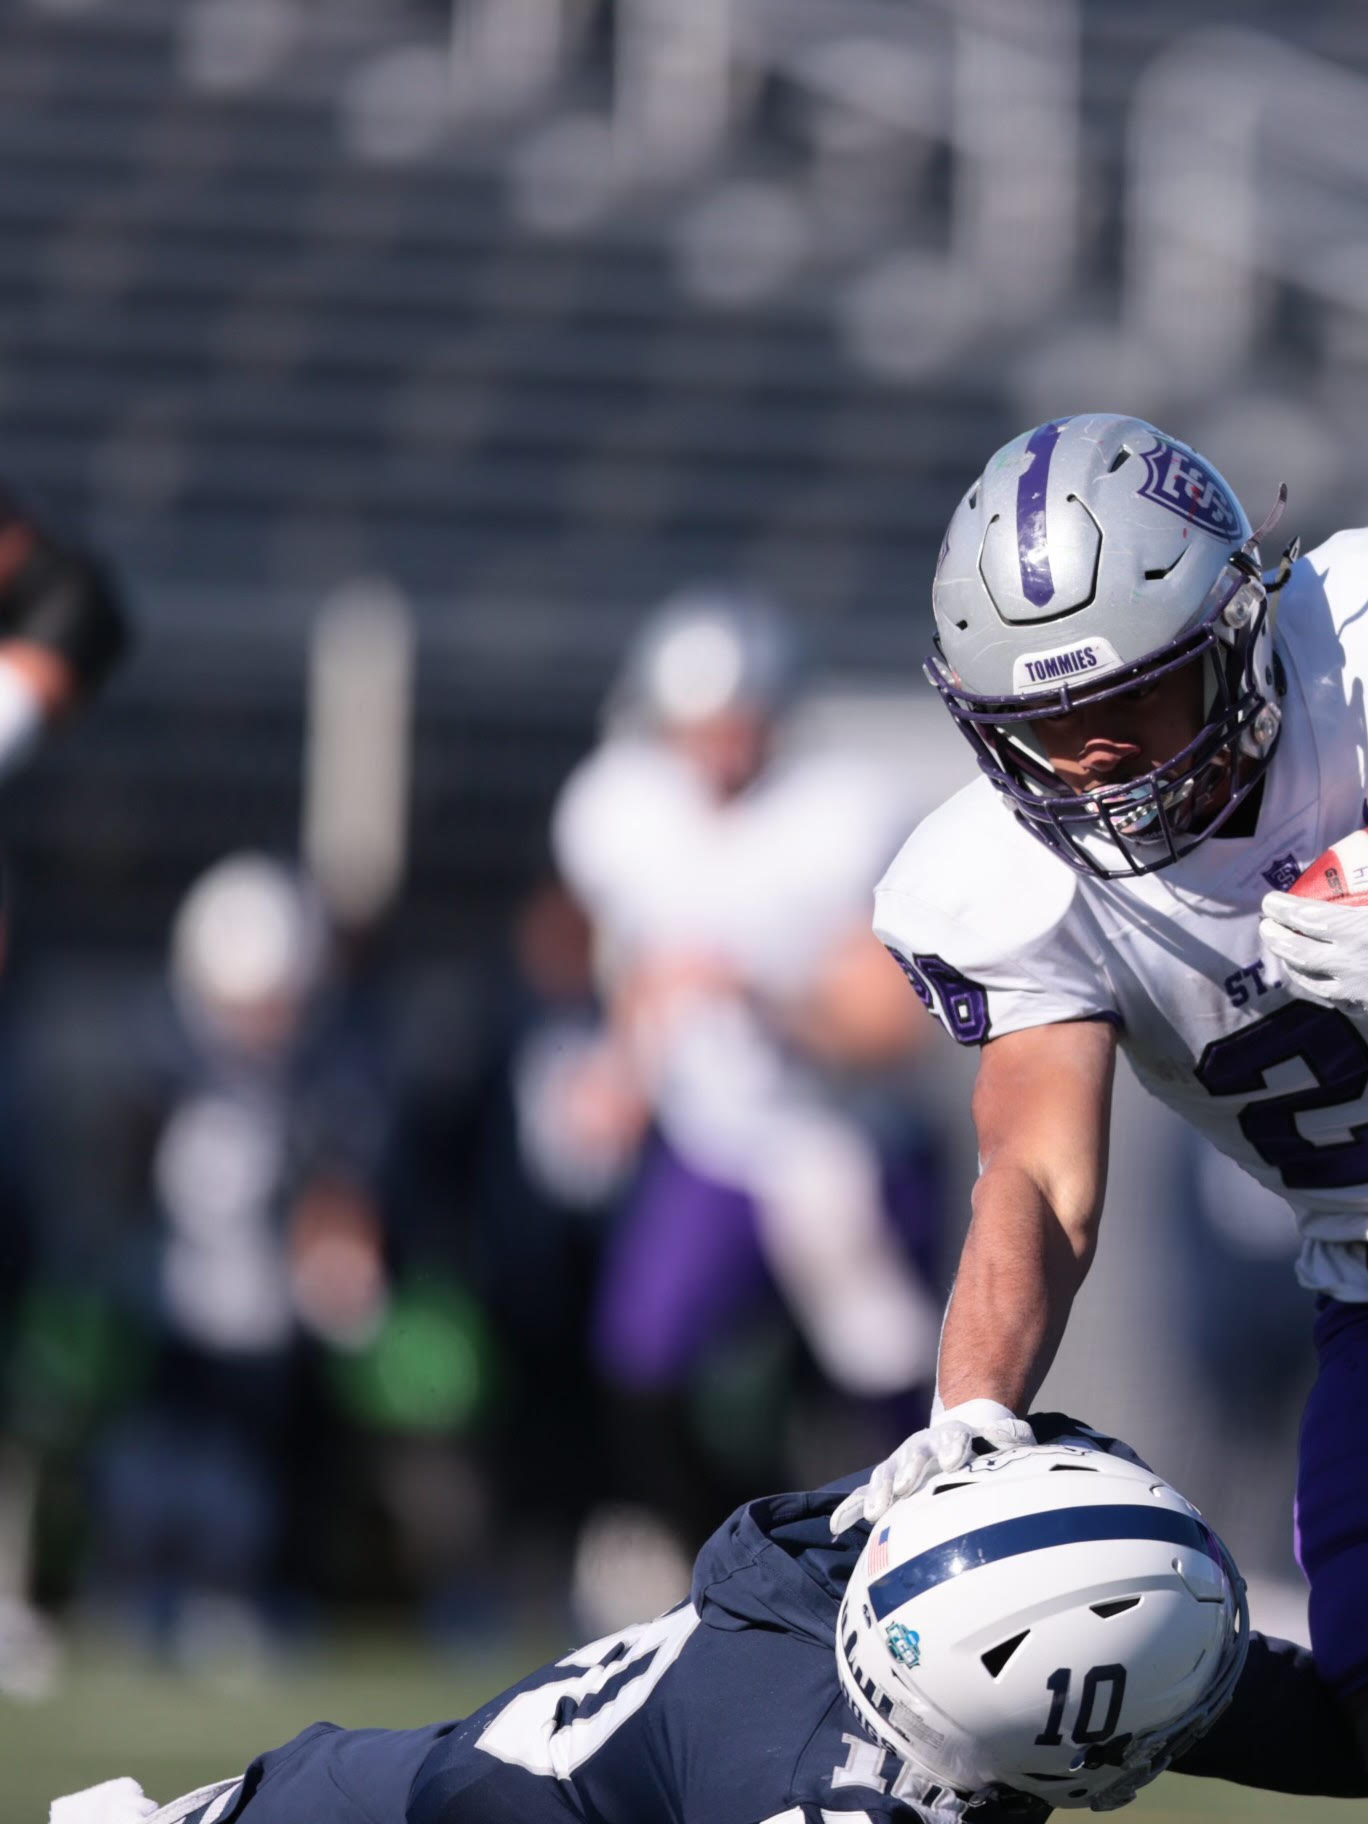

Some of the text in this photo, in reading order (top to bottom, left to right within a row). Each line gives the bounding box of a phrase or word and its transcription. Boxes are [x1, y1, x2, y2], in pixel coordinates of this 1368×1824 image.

[1024, 646, 1097, 682] TOMMIES
[1224, 957, 1283, 1008] ST.
[1033, 1662, 1127, 1746] 10
